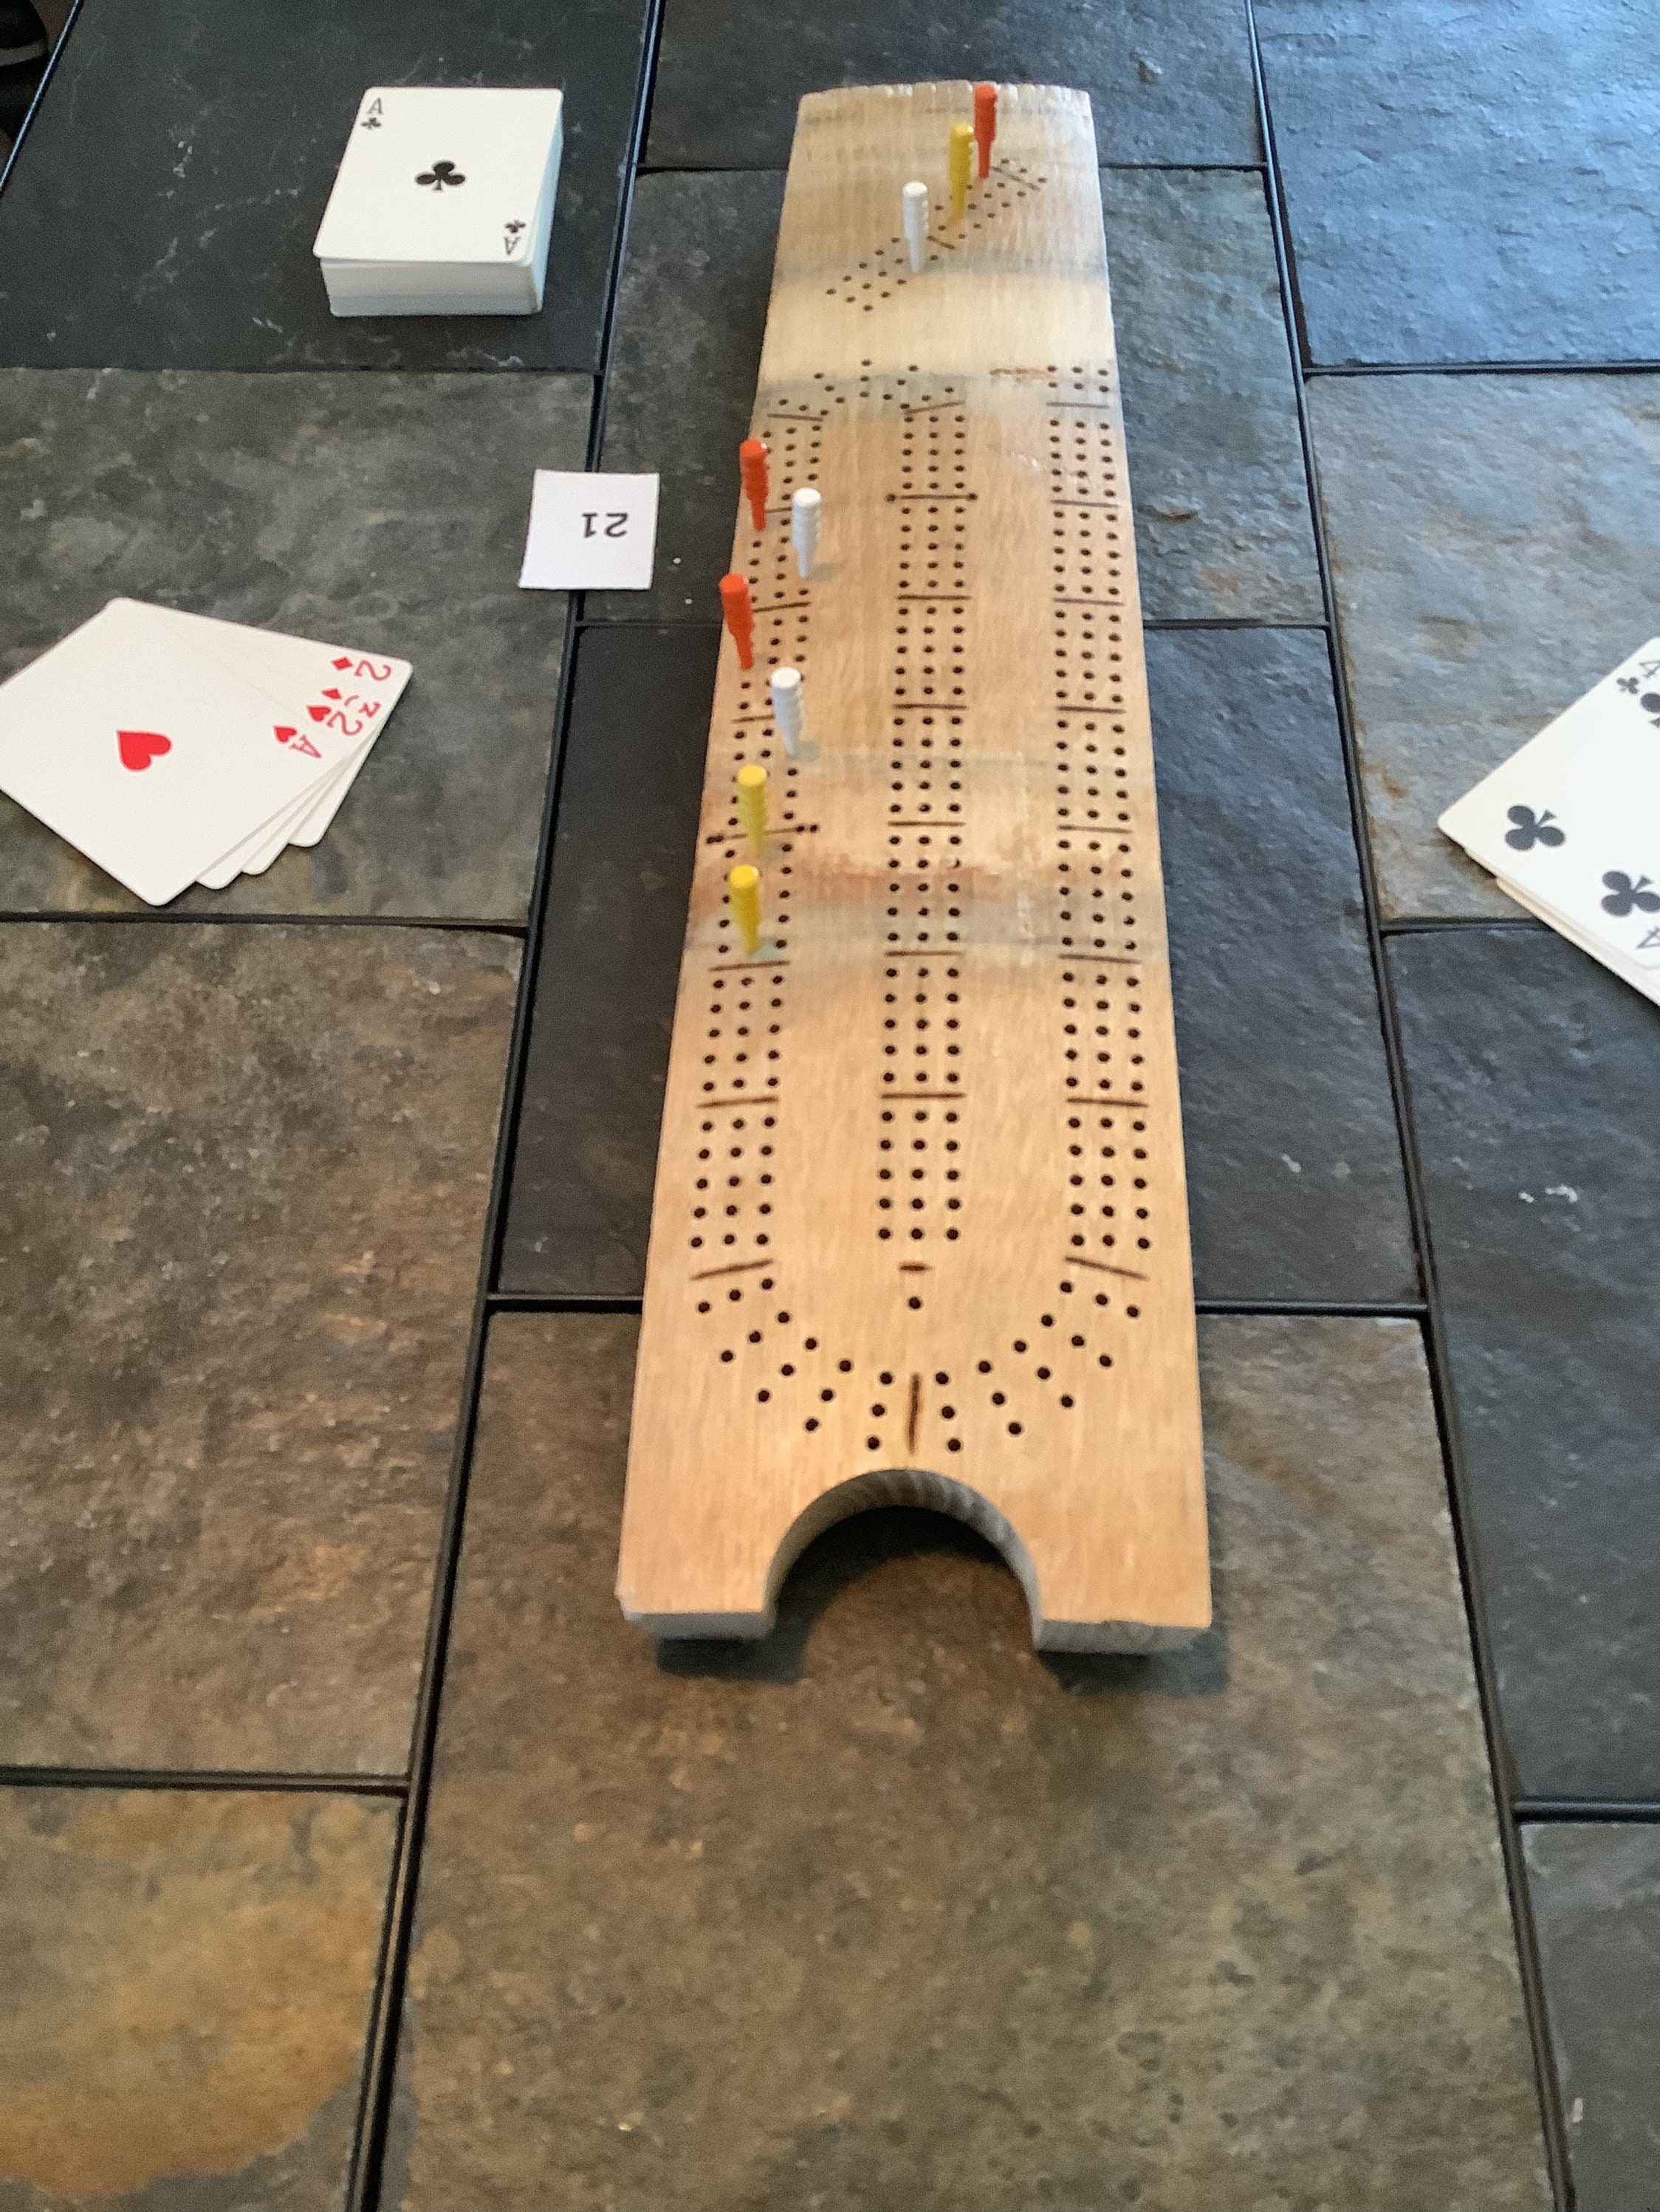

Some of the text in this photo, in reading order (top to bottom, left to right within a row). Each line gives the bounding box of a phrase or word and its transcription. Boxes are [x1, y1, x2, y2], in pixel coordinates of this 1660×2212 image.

[367, 97, 384, 114] A
[503, 236, 521, 255] A
[582, 512, 629, 538] 21
[354, 659, 391, 681] 2
[327, 711, 363, 736] 2
[289, 735, 322, 759] A
